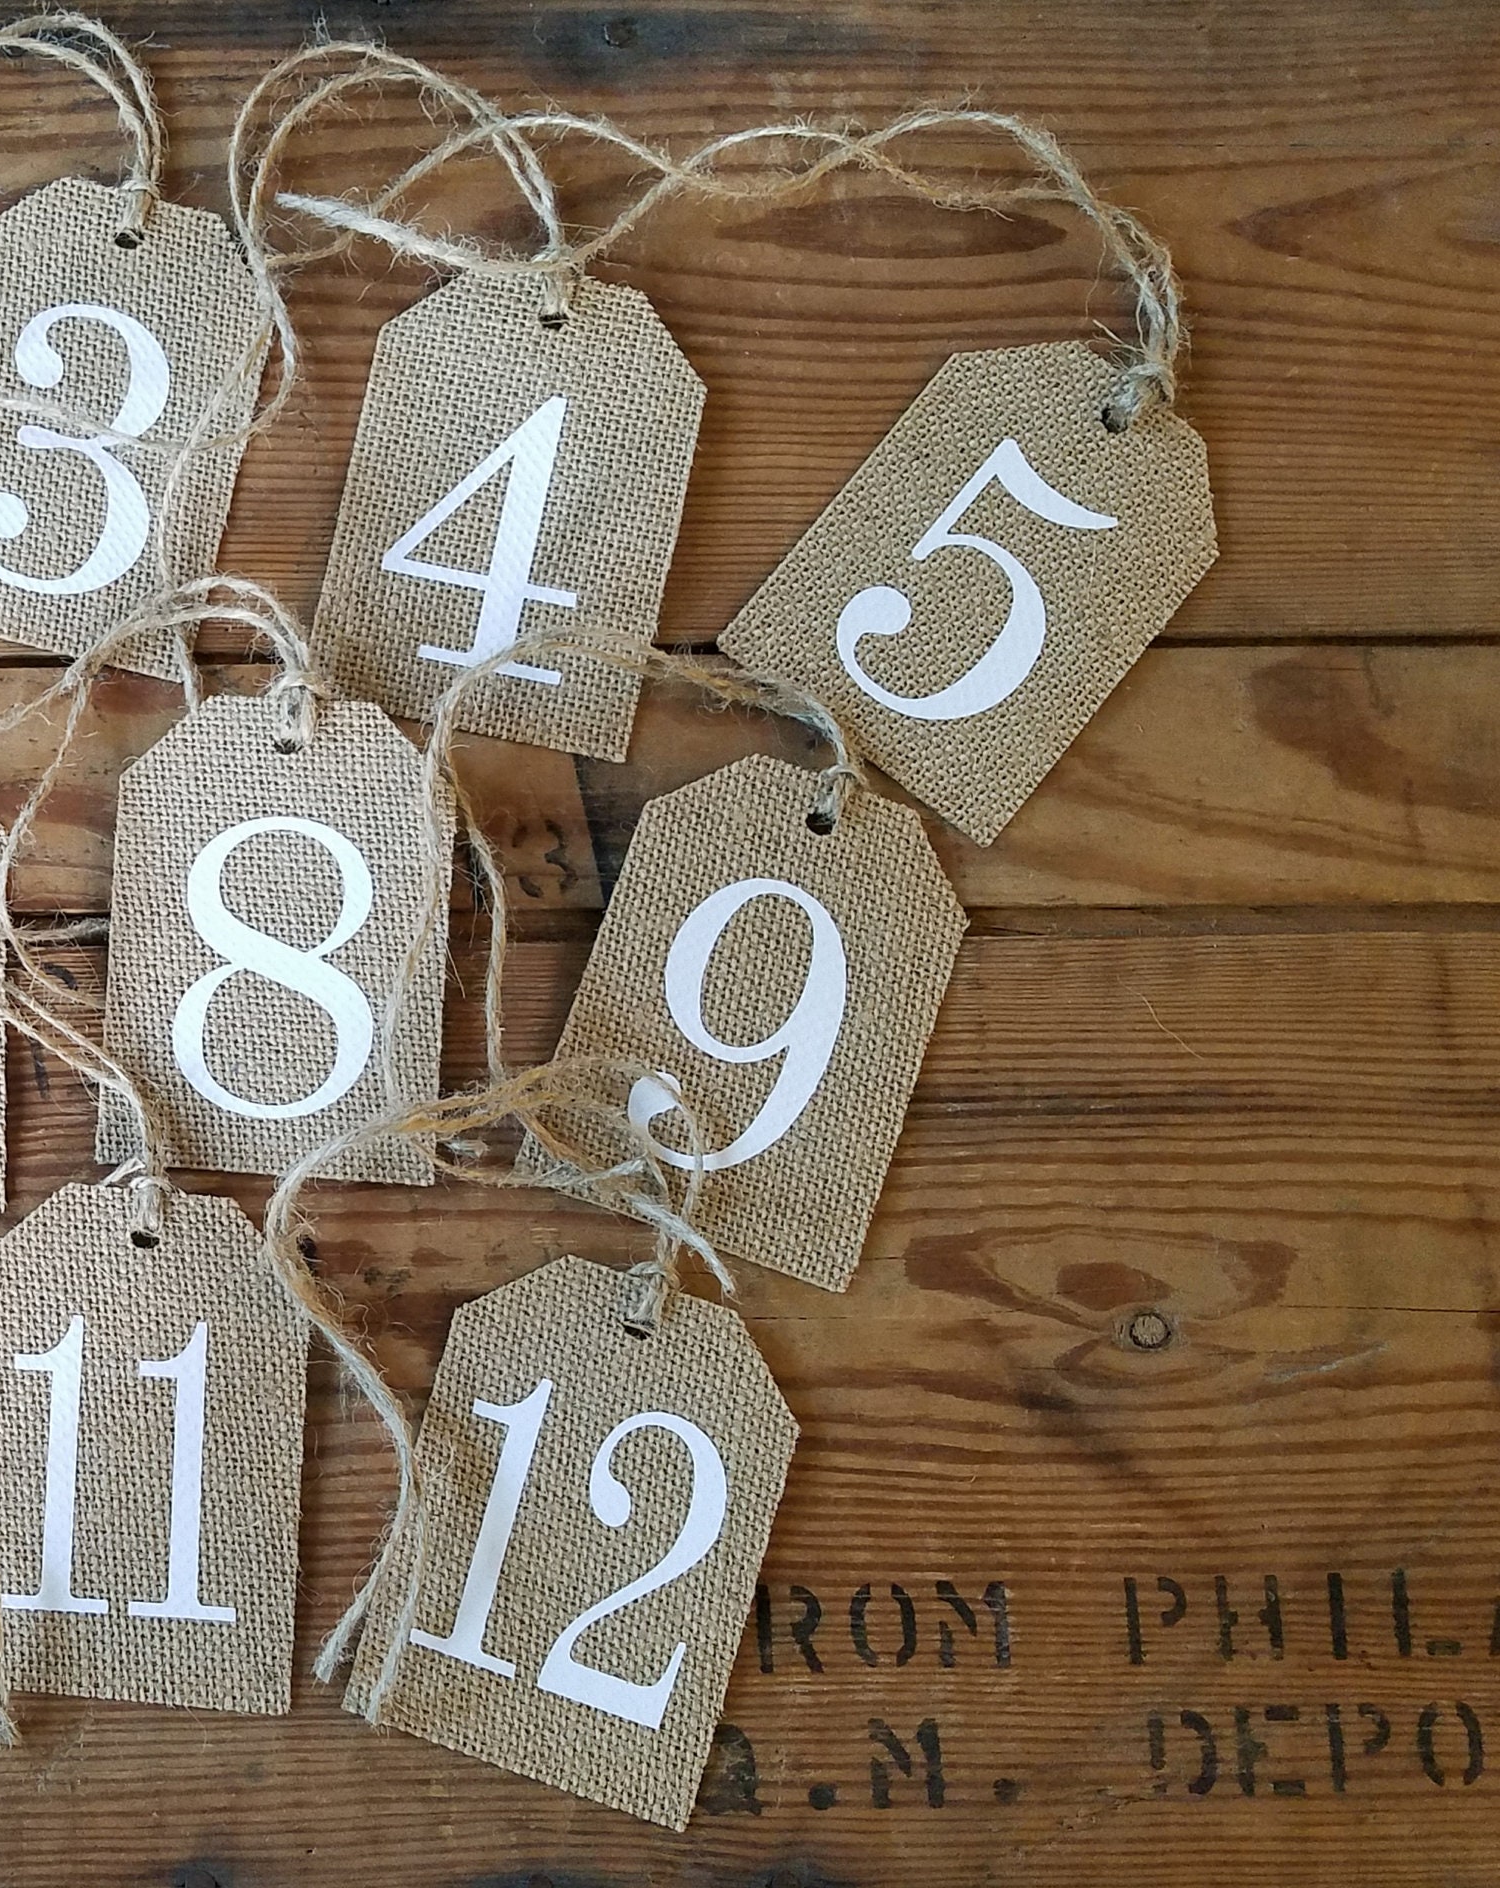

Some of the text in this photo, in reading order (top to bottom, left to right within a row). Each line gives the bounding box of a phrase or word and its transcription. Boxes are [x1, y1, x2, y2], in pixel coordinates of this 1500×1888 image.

[381, 396, 578, 687] 4
[836, 437, 1118, 721] 5
[171, 814, 375, 1121] 8
[627, 877, 848, 1172] 9
[0, 1313, 237, 1623] 11
[409, 1378, 728, 1730] 12
[1123, 1566, 1500, 1665] PHIL
[1146, 1699, 1484, 1797] DEPO
